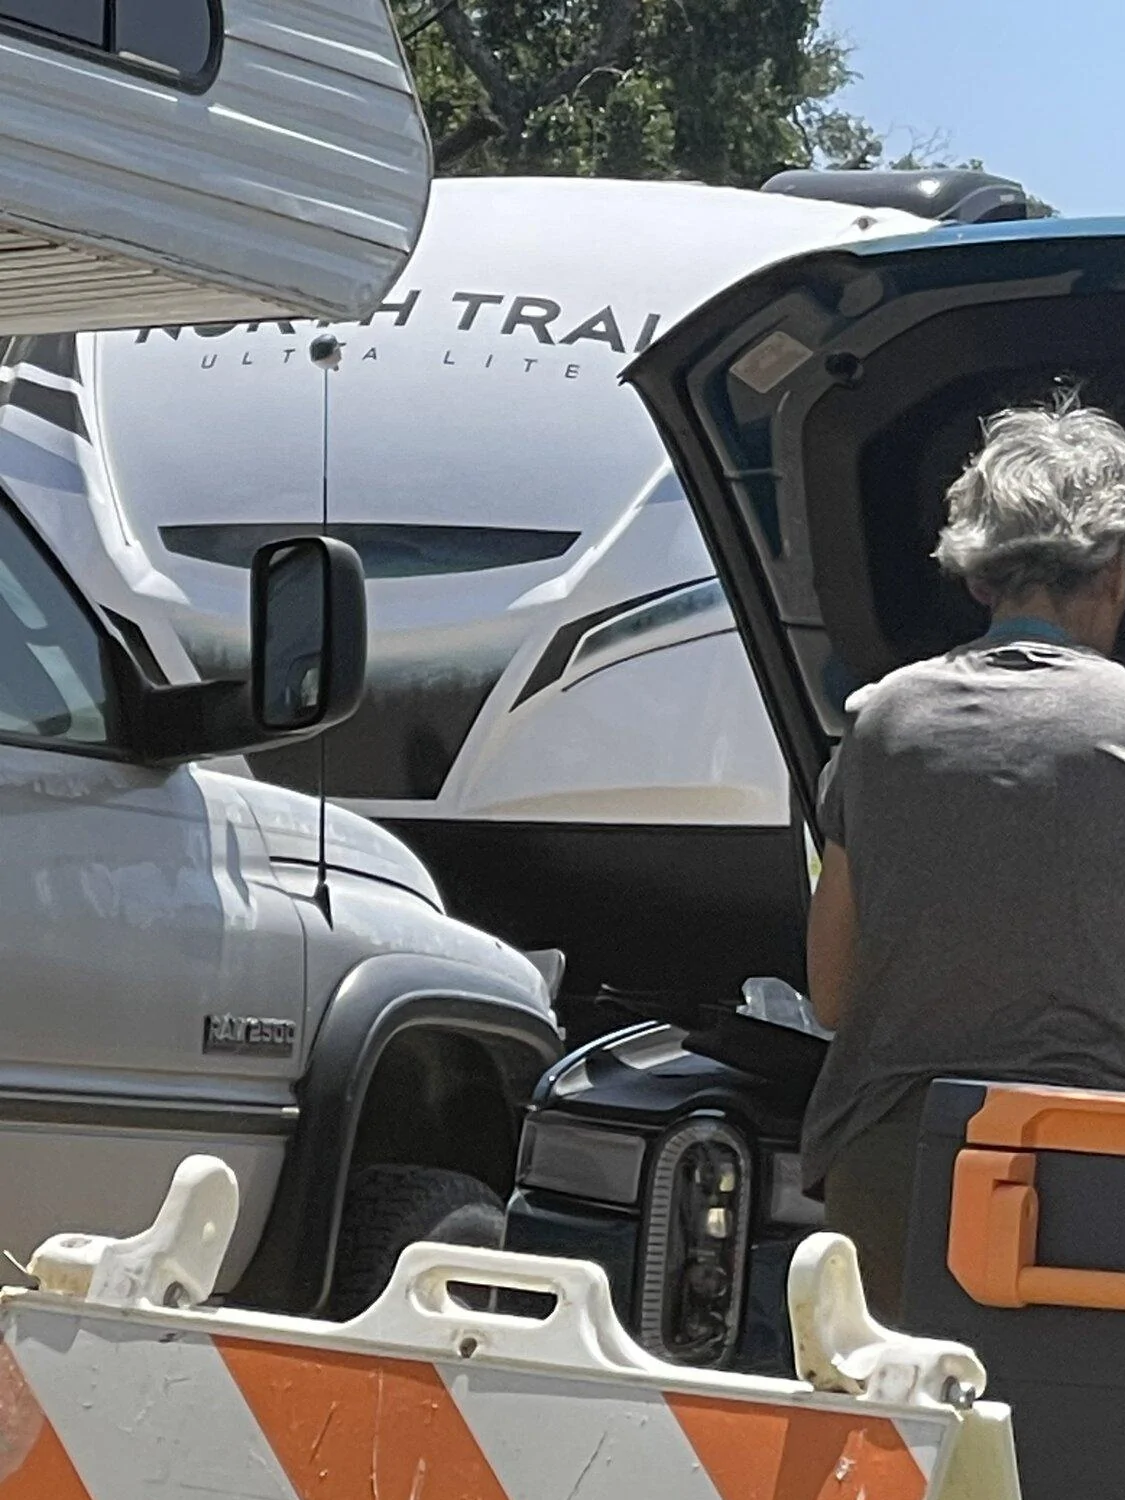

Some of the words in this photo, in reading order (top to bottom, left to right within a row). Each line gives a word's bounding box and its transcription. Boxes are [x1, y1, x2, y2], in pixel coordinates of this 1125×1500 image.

[452, 291, 662, 354] TRAI
[200, 346, 378, 370] ULTA
[442, 350, 581, 380] LITE
[248, 1017, 296, 1043] 2500
